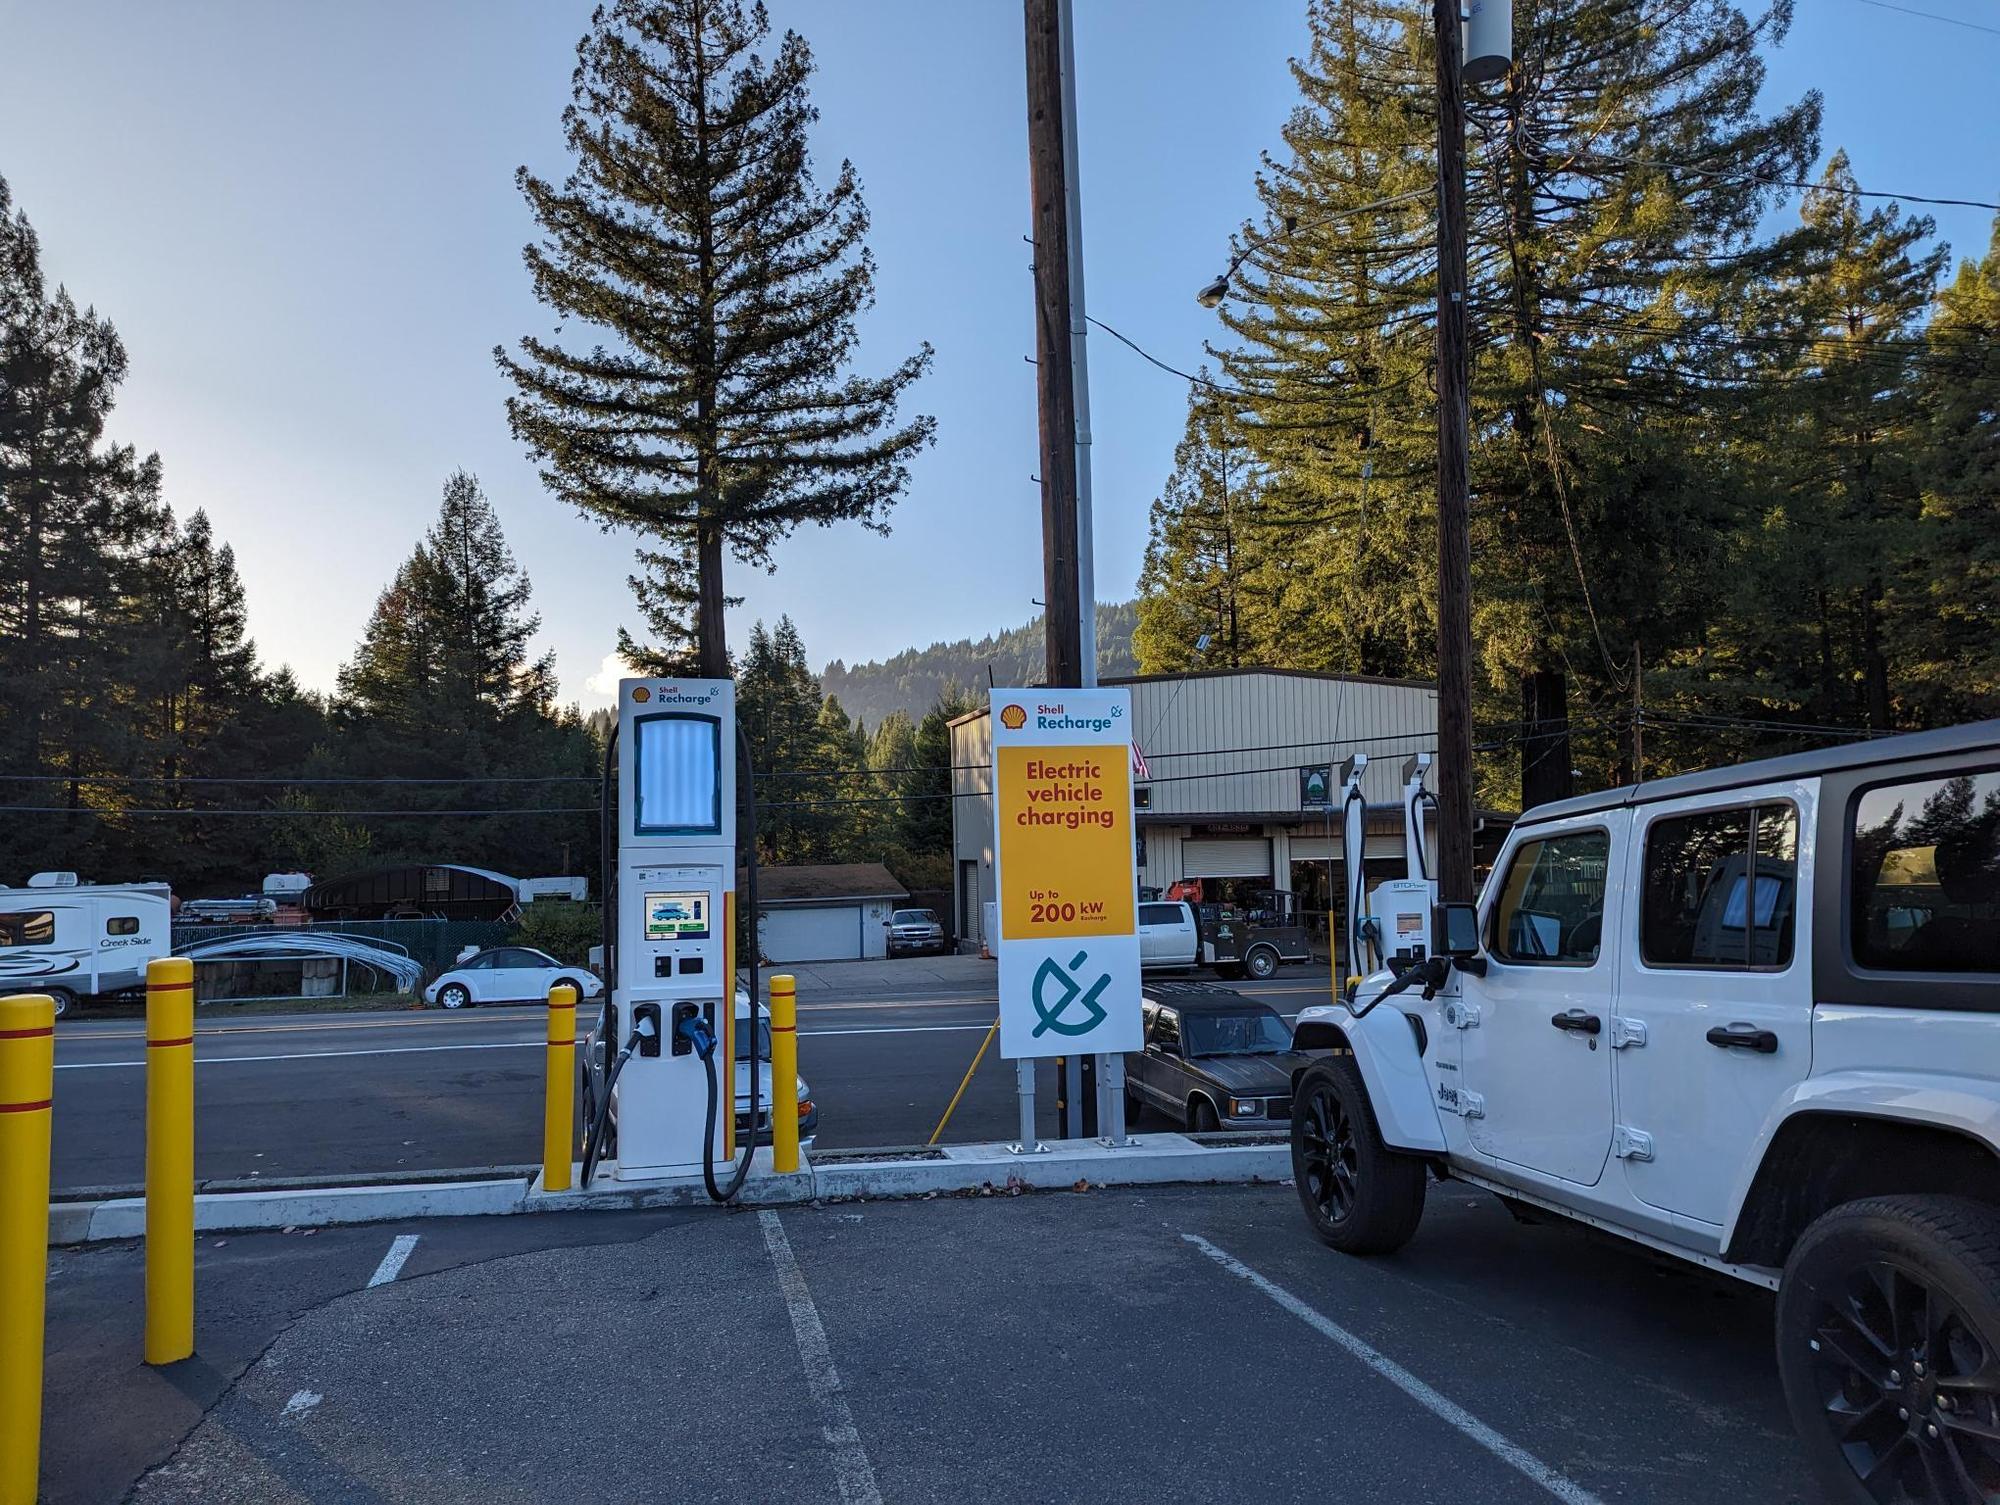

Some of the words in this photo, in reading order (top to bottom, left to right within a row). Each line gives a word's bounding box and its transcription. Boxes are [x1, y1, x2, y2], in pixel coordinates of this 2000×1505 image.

[659, 686, 678, 694] Shell
[658, 693, 711, 705] Recharge
[1037, 704, 1064, 714] Shell
[1037, 714, 1112, 732] Recharge
[1027, 760, 1101, 779] Electric
[1027, 782, 1103, 802] vehicle
[1017, 805, 1114, 829] charging
[1029, 890, 1045, 902] Up
[1048, 890, 1059, 899] to
[1031, 902, 1076, 923] 200
[1080, 902, 1104, 914] kW
[100, 939, 129, 948] Creek
[130, 937, 152, 946] Side
